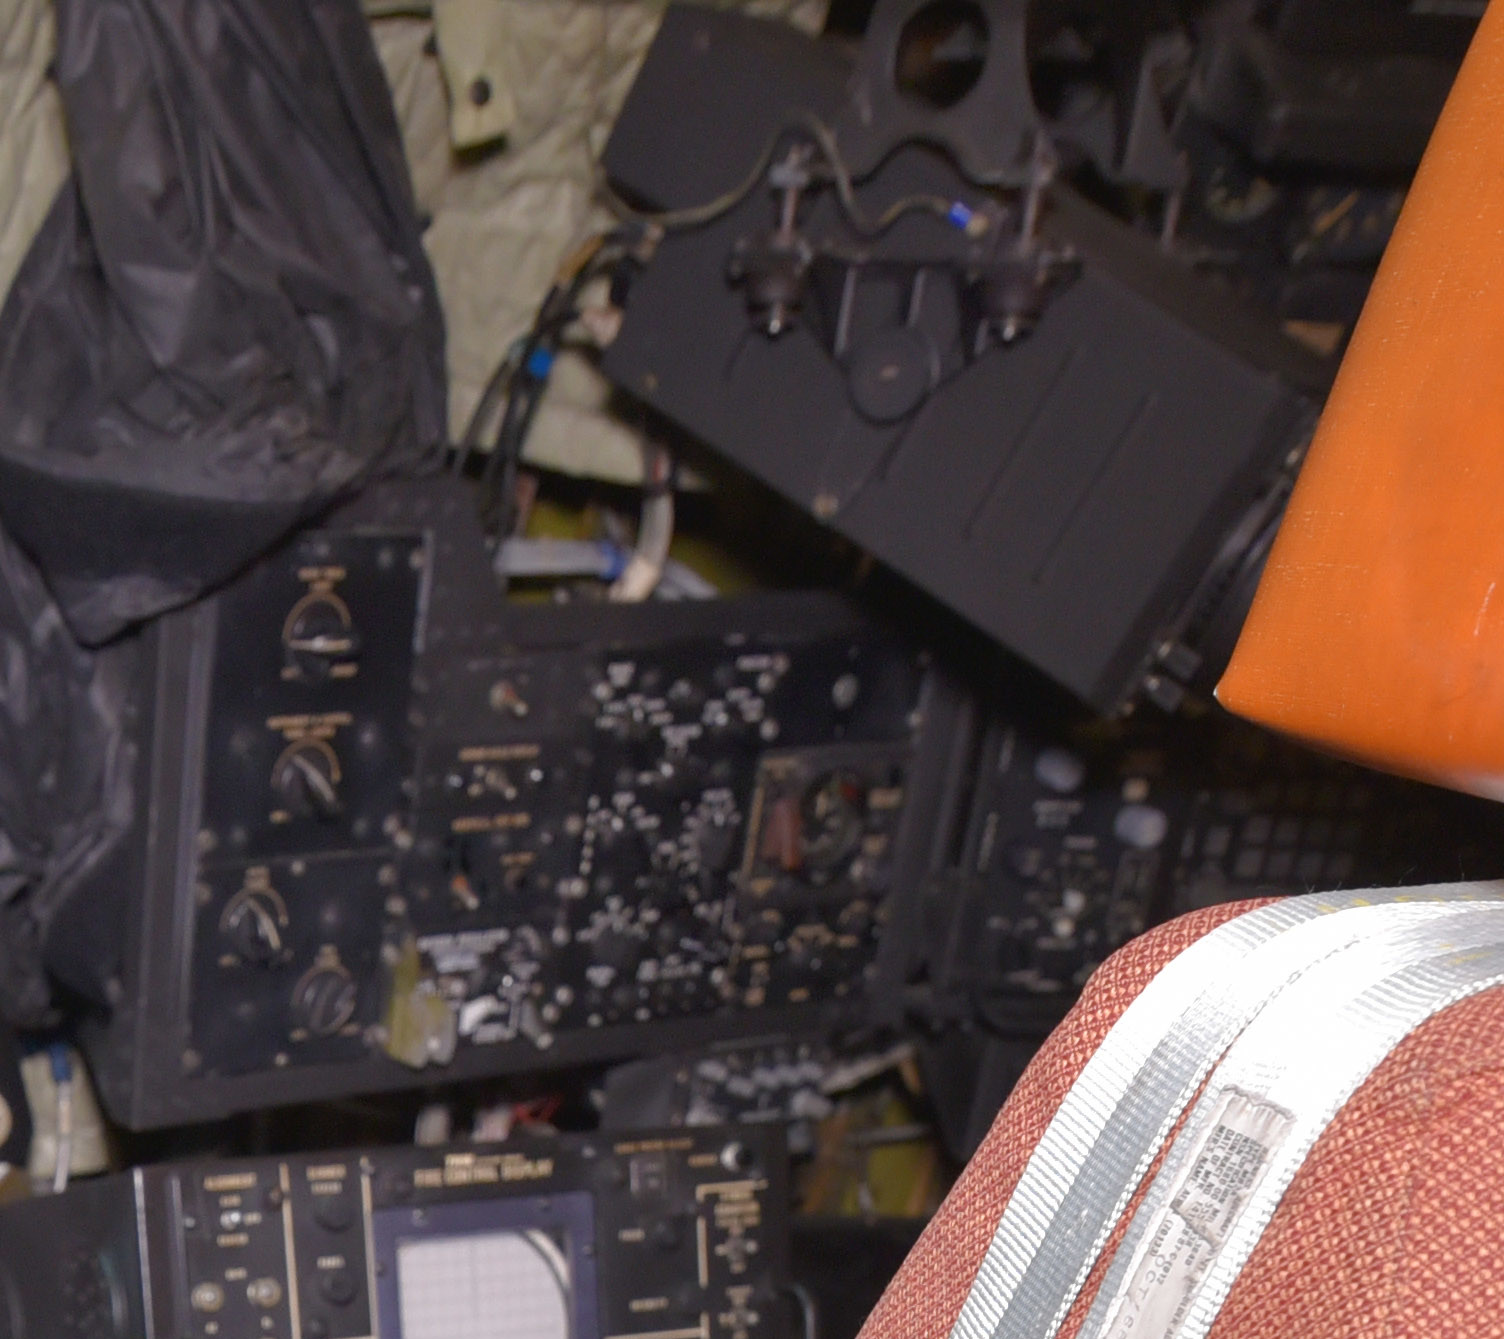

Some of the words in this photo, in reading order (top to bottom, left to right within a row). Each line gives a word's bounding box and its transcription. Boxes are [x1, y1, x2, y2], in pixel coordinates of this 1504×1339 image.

[1216, 1127, 1235, 1152] DATE
[1208, 1153, 1220, 1166] OF
[1212, 1131, 1243, 1179] CONTRACT
